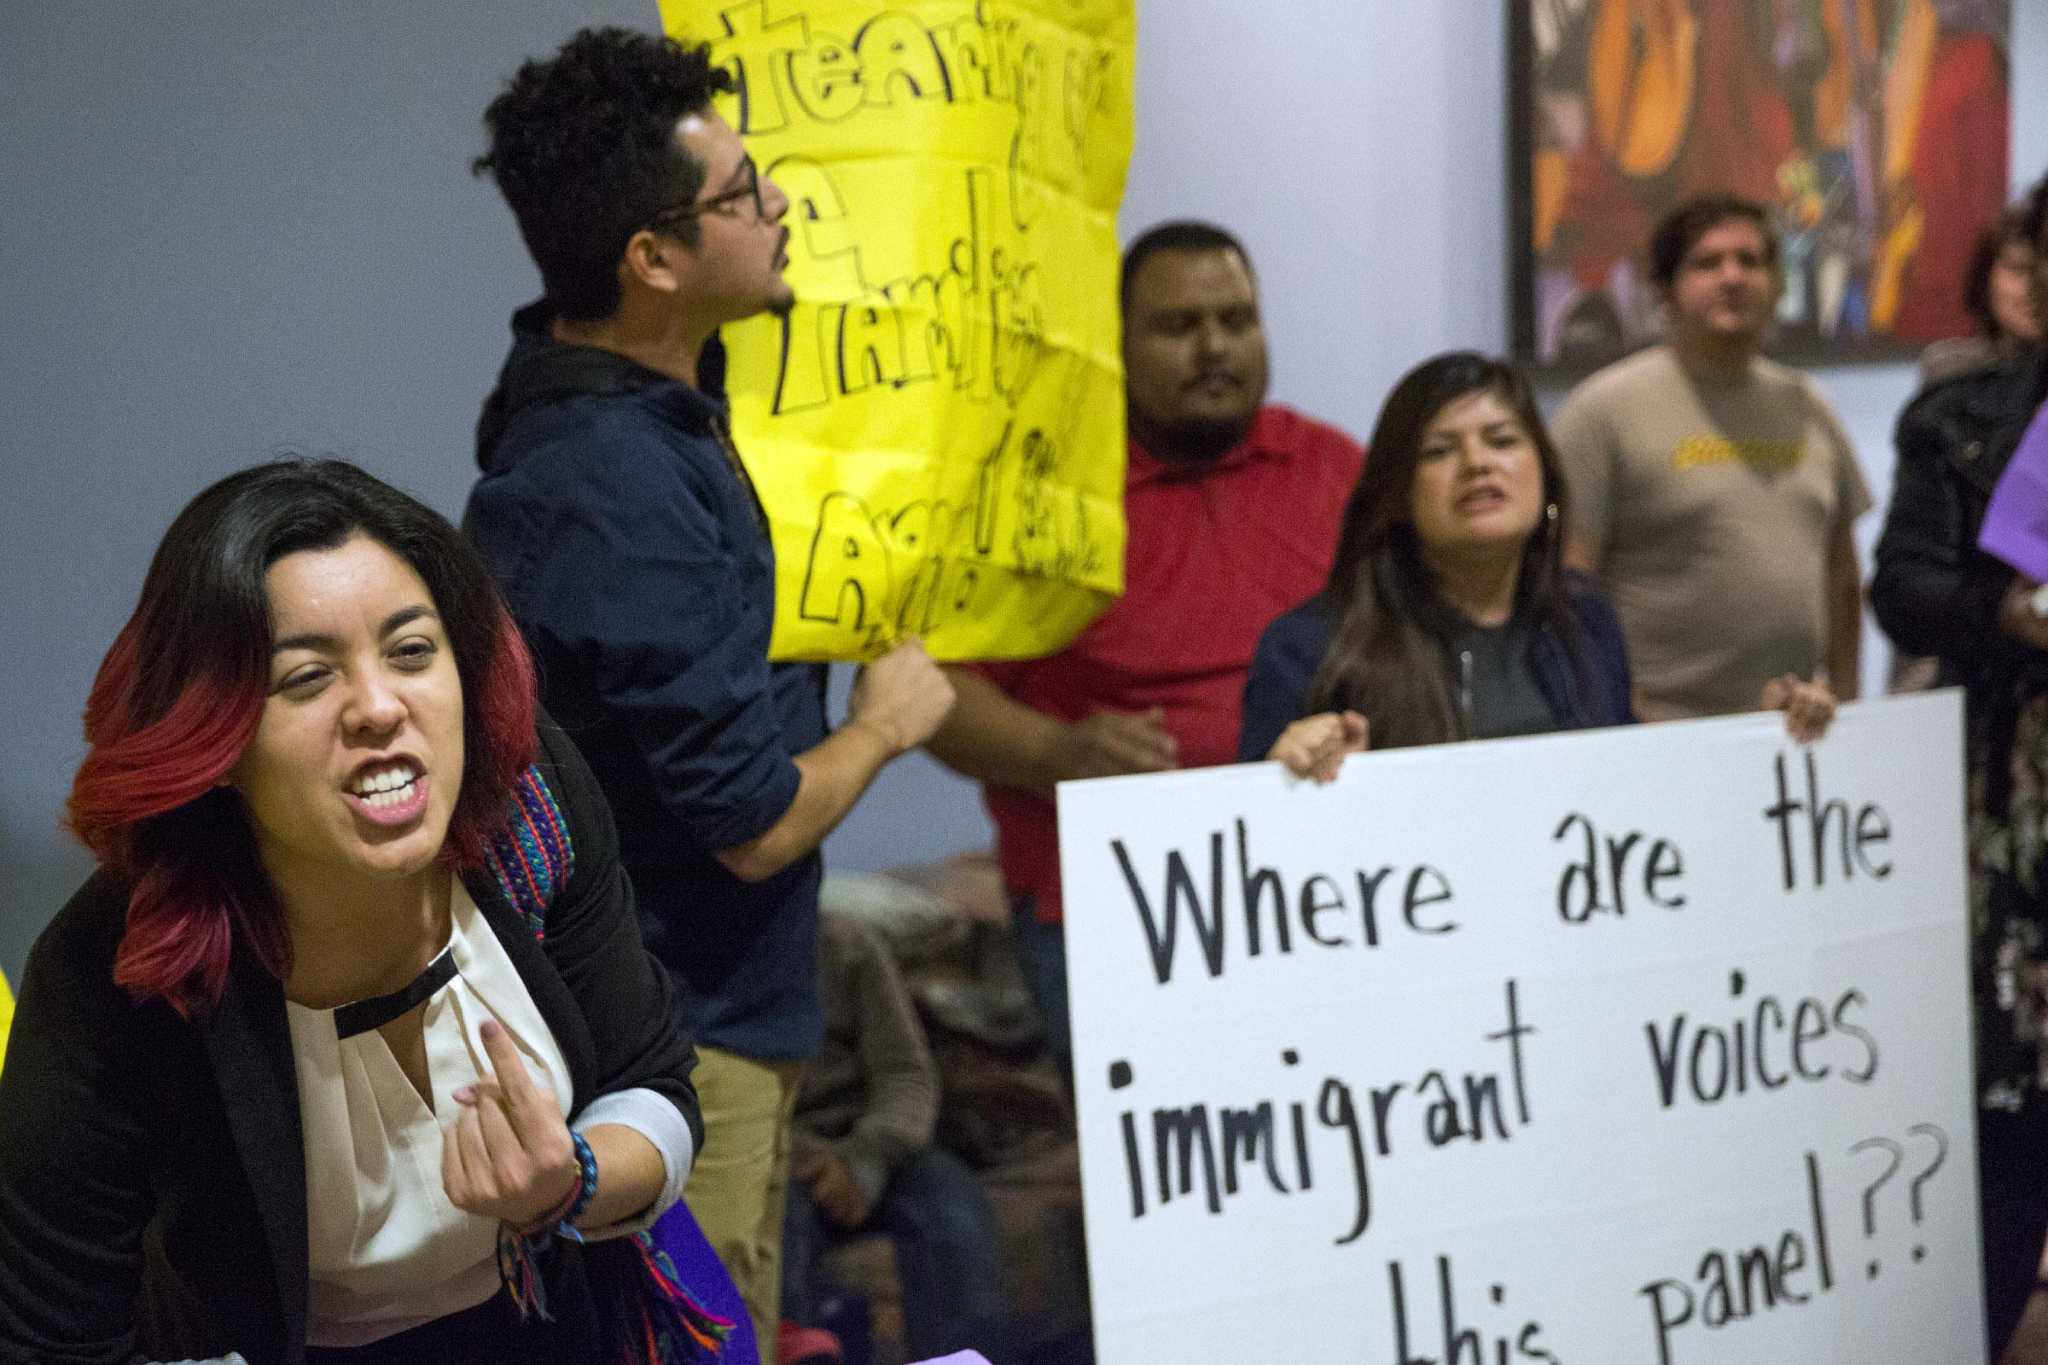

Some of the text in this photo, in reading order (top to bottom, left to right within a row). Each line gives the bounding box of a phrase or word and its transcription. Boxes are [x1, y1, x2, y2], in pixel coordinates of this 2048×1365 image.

[1109, 752, 1894, 984] Where are the
[1108, 970, 1878, 1246] immigrant voices
